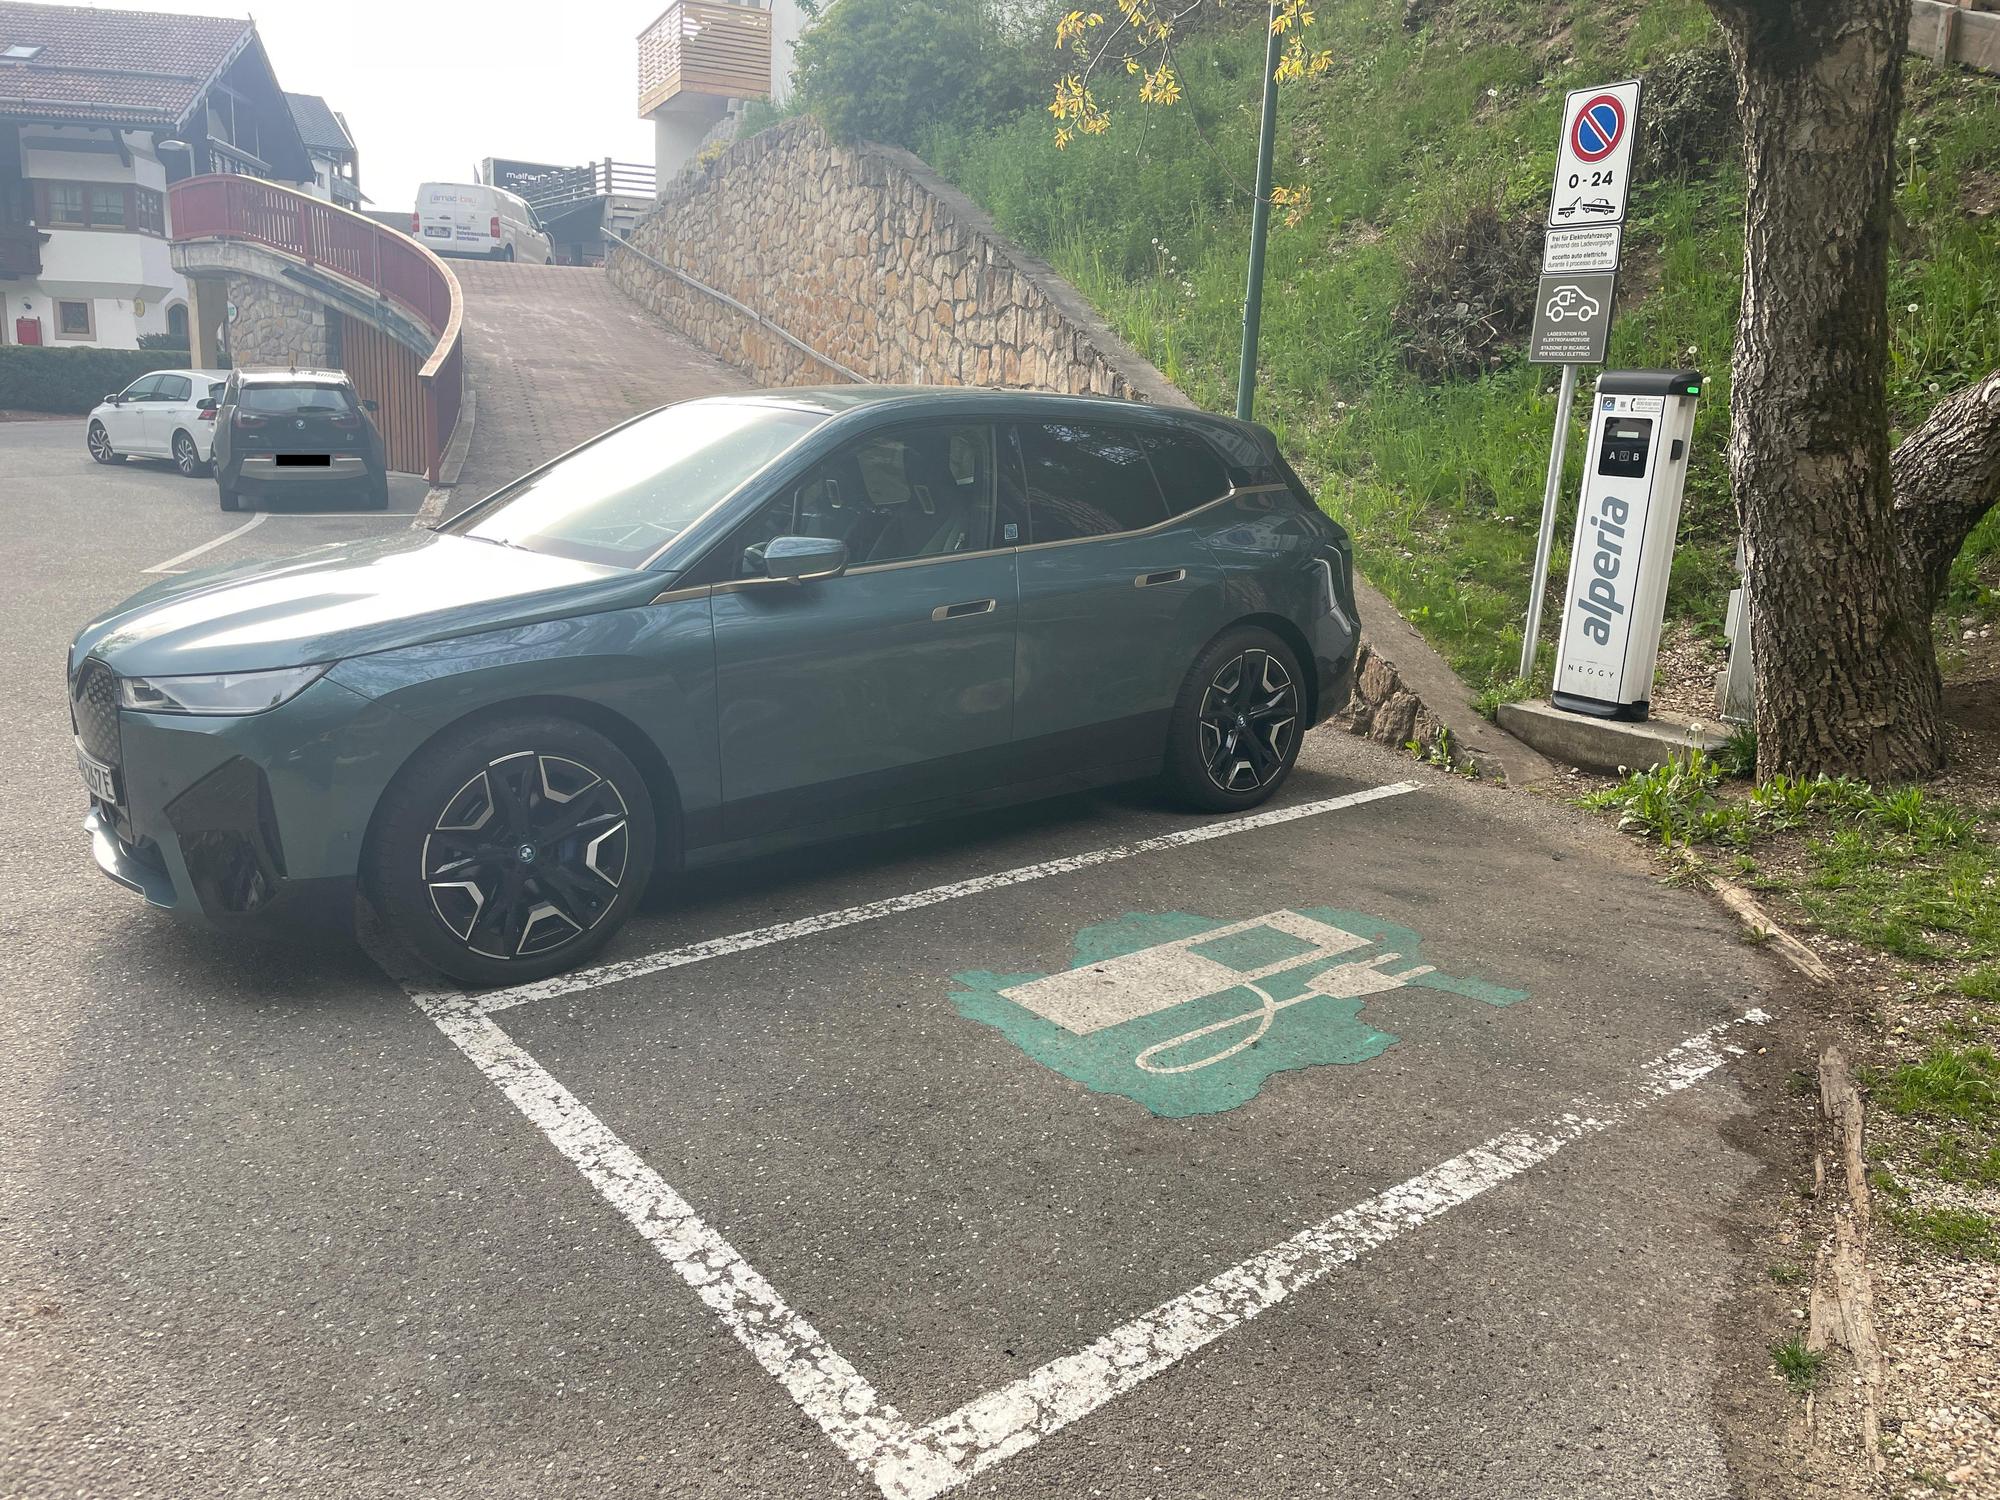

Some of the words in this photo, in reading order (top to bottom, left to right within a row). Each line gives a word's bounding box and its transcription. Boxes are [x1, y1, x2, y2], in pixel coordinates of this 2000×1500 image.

[1570, 232, 1613, 240] Elektrofahrzeuge
[1580, 239, 1615, 248] Ladevorgangs
[1569, 260, 1591, 268] processo
[1608, 451, 1616, 460] A
[1632, 452, 1640, 461] B
[1577, 495, 1630, 647] alperia
[1567, 664, 1615, 679] NEOGY
